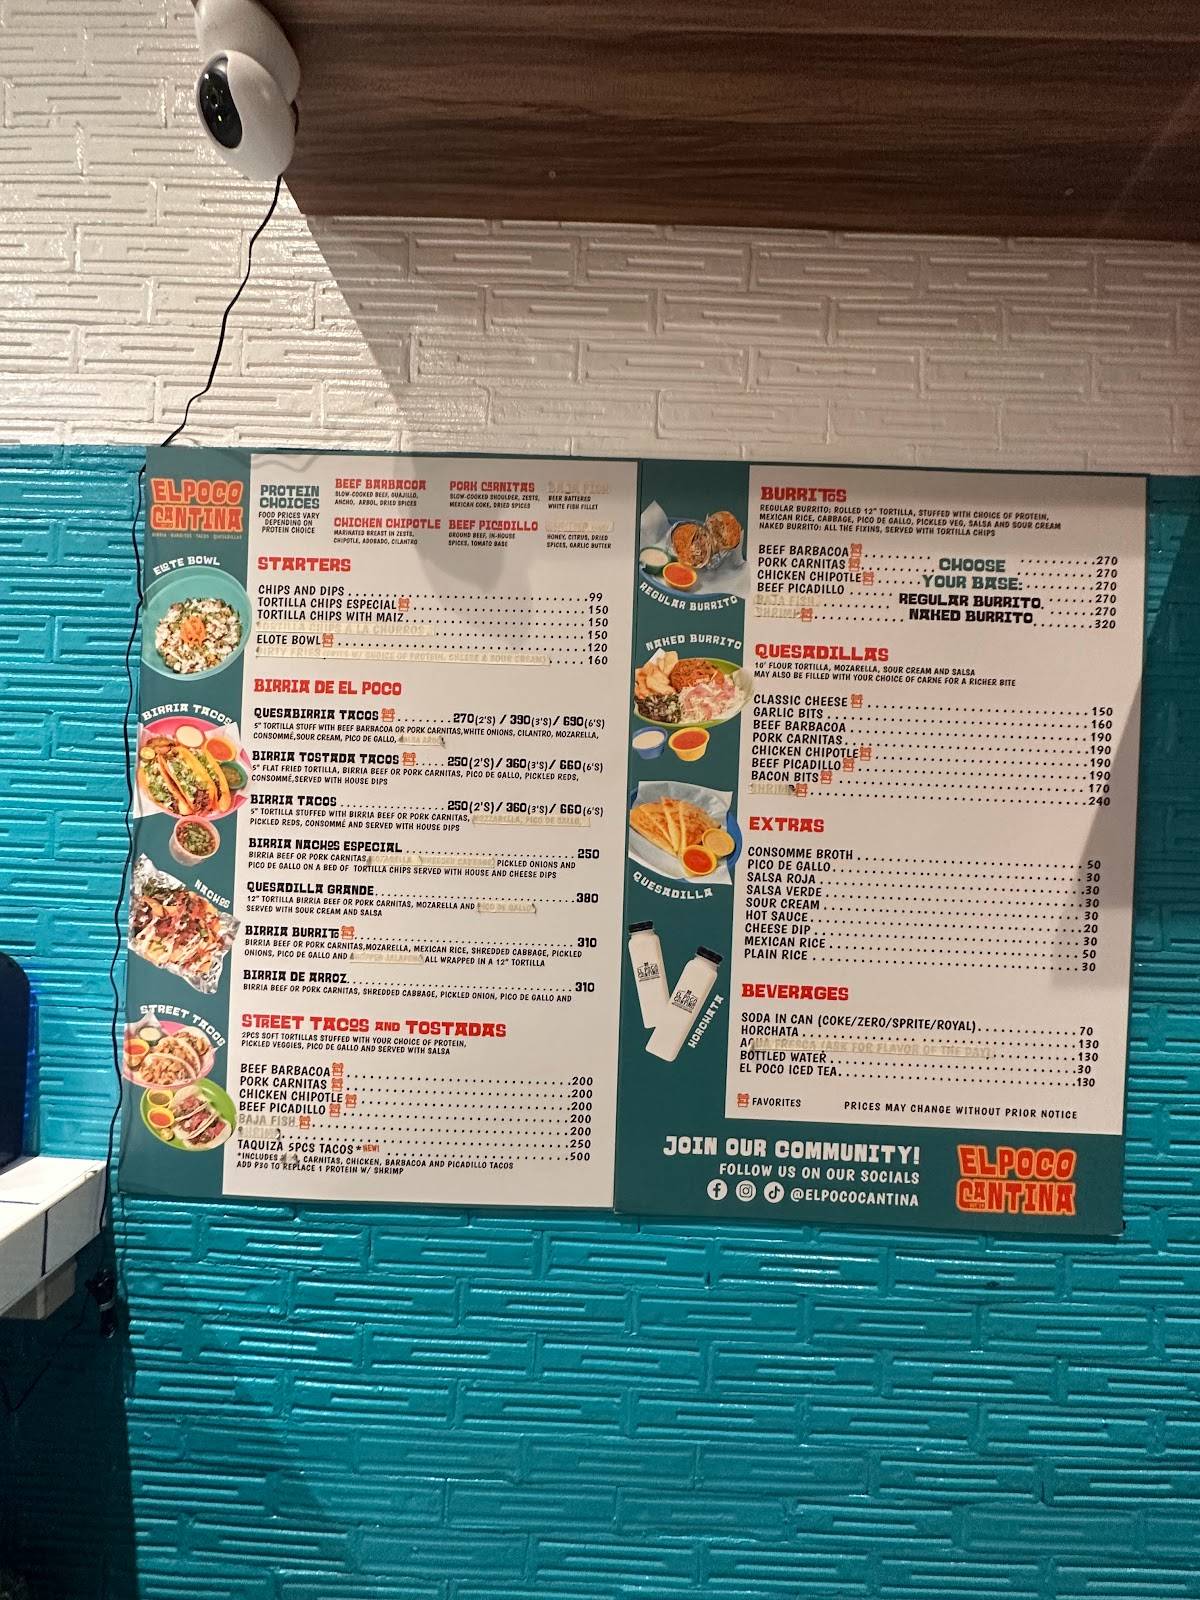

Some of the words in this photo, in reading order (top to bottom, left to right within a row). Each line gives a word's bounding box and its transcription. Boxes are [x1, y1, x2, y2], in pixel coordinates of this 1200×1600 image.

[260, 484, 319, 497] PROTEIN
[335, 478, 362, 489] BEEF
[365, 479, 426, 490] BARBACOA
[450, 481, 477, 492] PORK
[481, 481, 534, 492] CARNITAS
[260, 497, 319, 509] CHOICES
[760, 486, 846, 502] BURRITOS
[151, 504, 243, 532] CANTINA
[264, 518, 301, 526] DEPENDING
[334, 517, 382, 528] CHICKEN
[385, 518, 441, 529] CHIPOTLE
[448, 519, 475, 530] BEEF
[478, 520, 538, 531] PICADILLO
[839, 524, 853, 532] THE
[936, 527, 970, 536] TORTILLA
[758, 544, 785, 554] BEEF
[789, 545, 848, 557] BARBACOA
[1096, 556, 1117, 565] 270
[153, 558, 185, 576] ELOTE
[187, 556, 220, 566] BOWL
[258, 556, 350, 572] STARTERS
[939, 558, 1006, 572] CHOOSE
[922, 575, 966, 589] YOUR
[972, 576, 1023, 591] BASE:
[258, 584, 290, 595] CHIPS
[294, 585, 316, 595] AND
[320, 586, 344, 596] DIPS
[589, 592, 602, 602] 99
[640, 582, 686, 610] REGULAR
[690, 596, 738, 611] BURRITO
[257, 609, 305, 620] TORTILLA
[310, 610, 341, 621] CHIPS
[346, 611, 372, 621] WITH
[376, 612, 403, 622] MAIZ
[588, 617, 608, 627] 150
[910, 608, 961, 621] NAKED
[966, 610, 1033, 623] BURRITO
[256, 634, 287, 644] ELOTE
[291, 635, 321, 645] BOWL
[588, 643, 607, 652] 120
[646, 635, 686, 651] NAKED
[690, 634, 742, 650] BURRITO
[755, 643, 888, 661] QUESADILLAS
[254, 678, 310, 693] BIRRIA
[314, 680, 334, 694] DE
[338, 680, 357, 694] EL
[362, 681, 401, 695] POCO
[142, 703, 189, 721] BIRRIA
[193, 705, 233, 725] TACOS
[254, 707, 335, 719] QUESABIRRIA
[339, 709, 378, 720] TACOS
[754, 694, 800, 705] CLASSIC
[804, 696, 847, 707] CHEESE
[1092, 707, 1112, 716] 150
[252, 750, 295, 761] BIRRIA
[298, 752, 355, 763] TOSTADA
[359, 753, 399, 764] TACOS
[751, 770, 789, 781] BACON
[794, 772, 818, 782] BITS
[1089, 784, 1109, 793] 170
[749, 816, 824, 832] EXTRAS
[248, 838, 291, 849] BIRRIA
[295, 839, 340, 850] NACHOS
[343, 841, 402, 852] ESPECIAL
[578, 848, 599, 859] 250
[748, 846, 812, 858] CONSOMME
[816, 849, 852, 860] BROTH
[1088, 861, 1101, 869] 50
[748, 859, 773, 870] PICO
[778, 860, 792, 870] DE
[796, 860, 830, 872] GALLO
[1087, 873, 1100, 882] 30
[194, 879, 231, 909] NACHOS
[247, 881, 323, 894] QUESADILLA
[327, 884, 374, 895] GRANDE
[576, 892, 598, 903] 380
[633, 871, 713, 899] QUESADILLA
[246, 904, 273, 912] SERVED
[295, 906, 314, 914] SOUR
[360, 908, 382, 916] SALSA
[245, 925, 288, 936] BIRRIA
[292, 926, 339, 938] BURRITO
[577, 937, 597, 947] 310
[243, 969, 286, 981] BIRRIA
[290, 971, 305, 981] DE
[575, 982, 594, 992] 310
[741, 983, 848, 1000] BEVERAGES
[242, 1014, 304, 1029] STREET
[310, 1016, 369, 1032] TACOS
[374, 1021, 400, 1031] AND
[405, 1020, 506, 1037] TOSTADAS
[688, 994, 724, 1049] HORCHATA
[741, 1012, 770, 1023] SODA
[775, 1013, 786, 1023] IN
[790, 1014, 812, 1024] CAN
[1080, 1027, 1093, 1036] 70
[752, 1097, 801, 1107] FAVORITES
[844, 1101, 880, 1111] PRICES
[885, 1103, 906, 1112] MAY
[910, 1104, 950, 1114] CHANGE
[956, 1106, 1000, 1116] WITHOUT
[1005, 1108, 1036, 1117] PRIOR
[1040, 1109, 1076, 1119] NOTICE
[238, 1140, 283, 1150] TAQUIZA
[289, 1143, 315, 1153] 5PCS
[570, 1151, 590, 1161] 500
[663, 1136, 717, 1155] JOIN
[726, 1138, 766, 1157] OUR
[775, 1140, 919, 1164] COMMUNITY!
[271, 1162, 280, 1170] TO
[283, 1164, 316, 1172] REPLACE
[325, 1165, 357, 1173] PROTEIN
[360, 1166, 371, 1174] W/
[719, 1163, 772, 1176] FOLLOW
[778, 1165, 796, 1178] US
[802, 1167, 820, 1179] ON
[826, 1168, 855, 1181] OUR
[860, 1169, 919, 1184] SOCIALS
[790, 1188, 919, 1206] @ELPOCOCANTINA
[956, 1179, 1076, 1215] CANTINA
